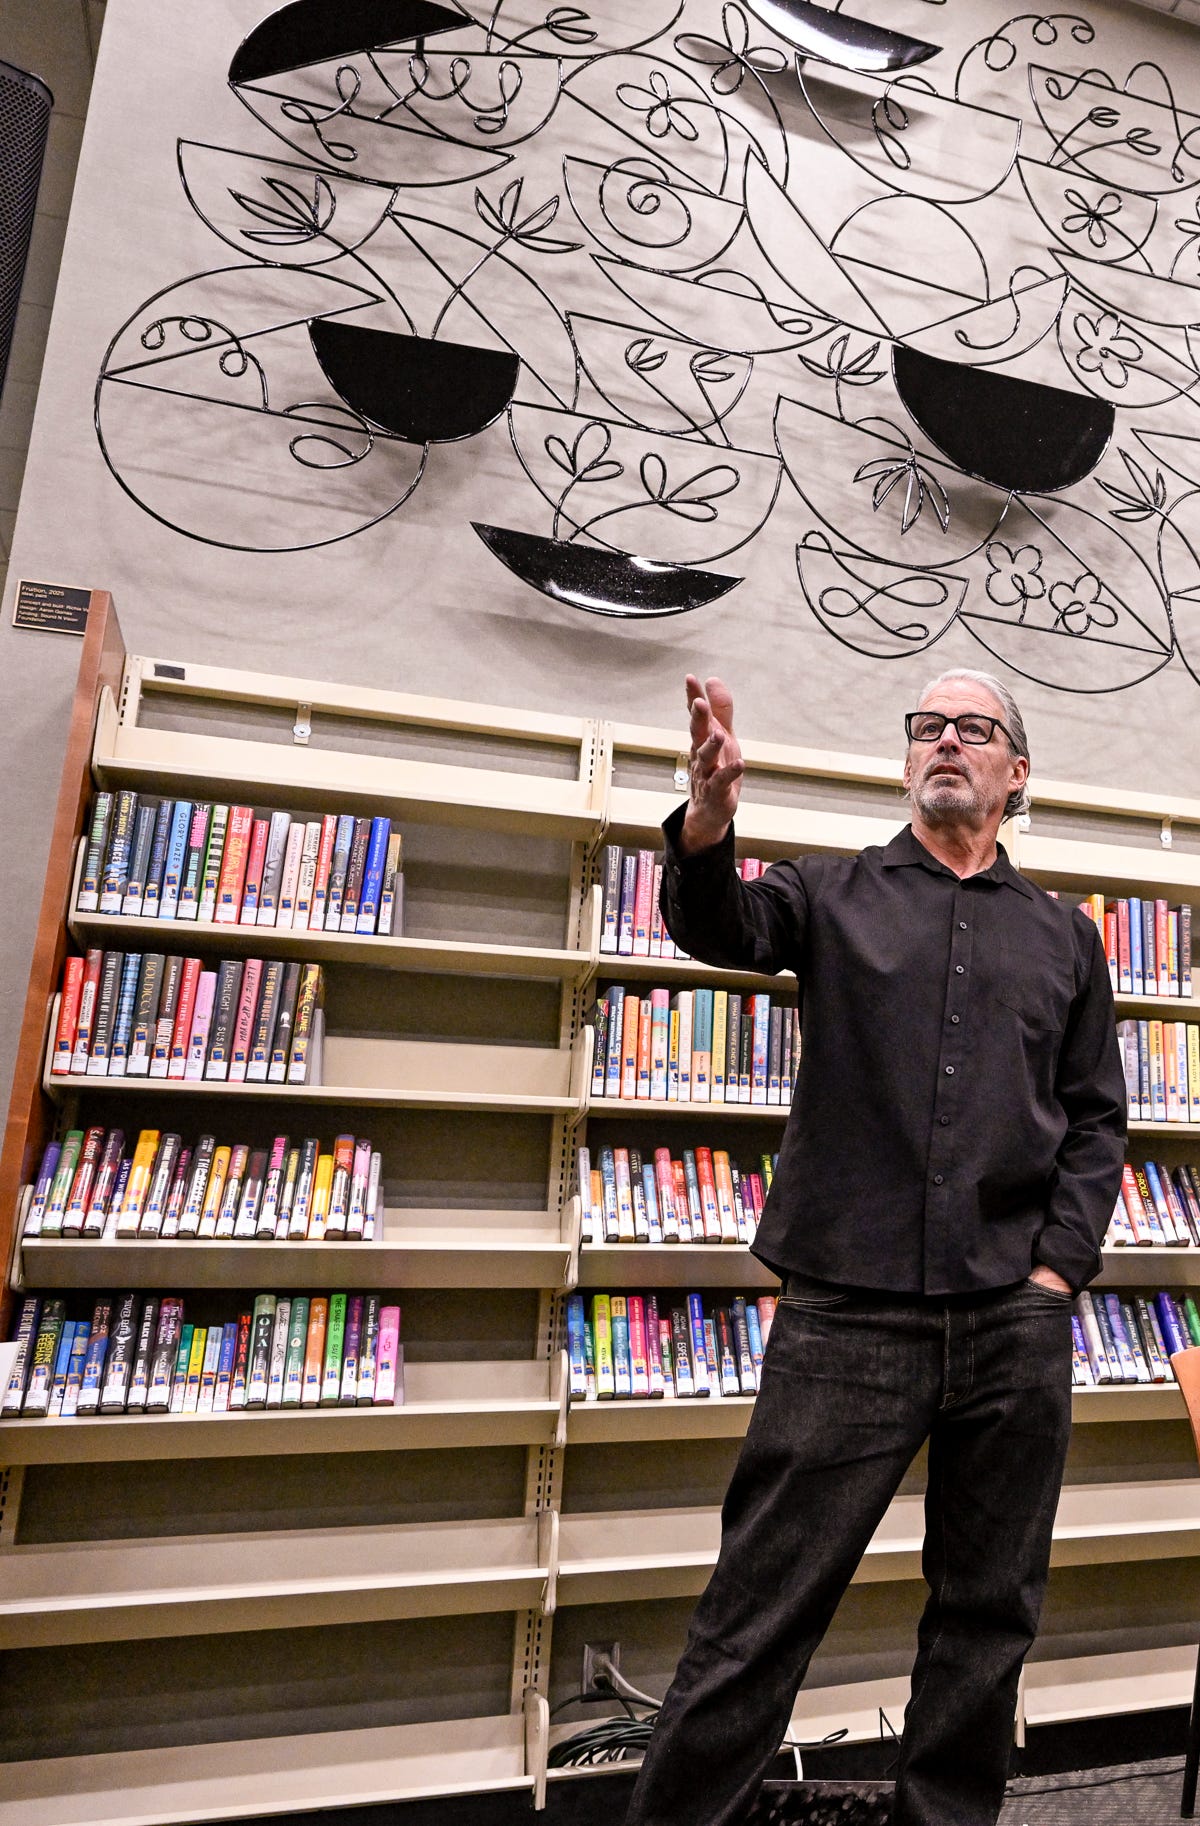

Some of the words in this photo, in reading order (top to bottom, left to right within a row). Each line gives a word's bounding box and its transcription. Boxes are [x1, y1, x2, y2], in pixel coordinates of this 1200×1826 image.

[177, 812, 187, 839] GLORY
[173, 843, 181, 862] DAZE
[351, 825, 361, 862] UNKNOWABLE
[307, 879, 313, 887] IN
[68, 962, 76, 984] Crush
[107, 958, 116, 969] THE
[267, 967, 278, 979] THE
[102, 970, 114, 1003] POSSESSION
[138, 961, 157, 1016] BOUDICCA
[181, 982, 191, 1002] DIVINE
[221, 966, 236, 1011] FLASHLIGHT
[264, 981, 275, 998] SURF
[165, 986, 174, 1012] CASTILLO
[260, 1000, 273, 1022] HOUSE
[299, 1005, 310, 1032] CLUNE
[615, 1002, 623, 1041] EPHEMERA
[215, 1026, 226, 1048] SUSA
[239, 1027, 248, 1042] YOU
[258, 1026, 268, 1040] LUCY
[84, 1140, 96, 1160] COSBY
[119, 1171, 129, 1183] YOU
[1135, 1172, 1148, 1197] SHROUD
[24, 1299, 36, 1312] THE
[171, 1306, 179, 1316] The
[19, 1313, 34, 1332] DEVIL
[141, 1321, 150, 1338] BLACK
[139, 1339, 147, 1352] HOPE
[166, 1330, 175, 1344] Days
[238, 1315, 251, 1363] MAYRA
[34, 1333, 48, 1364] FEEHAN
[44, 1333, 56, 1364] CHRISTINE
[115, 1345, 125, 1361] DANI
[677, 1342, 686, 1357] ESPE
